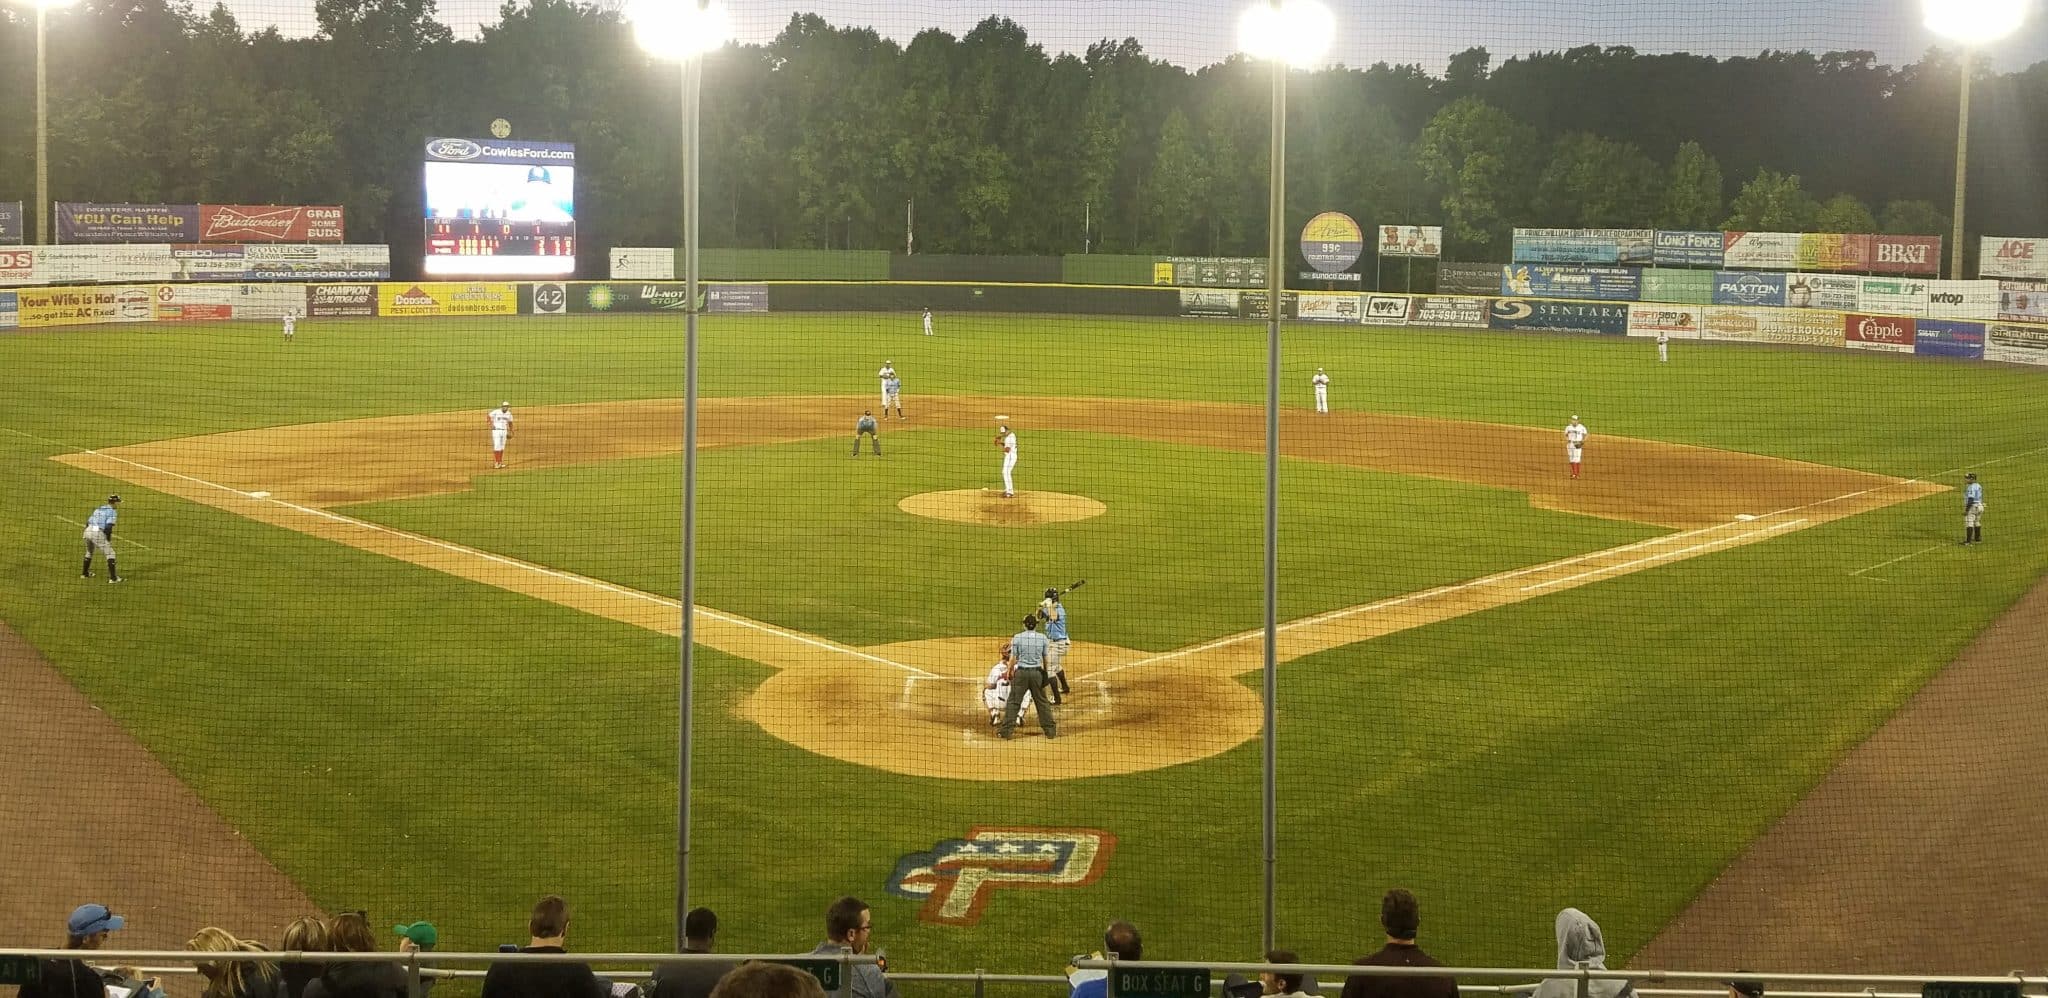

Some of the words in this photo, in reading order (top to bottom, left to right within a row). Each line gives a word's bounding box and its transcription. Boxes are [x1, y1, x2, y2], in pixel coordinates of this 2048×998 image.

[438, 142, 470, 156] Ford
[482, 146, 575, 160] CowlesFord.com
[74, 214, 105, 225] YOU
[110, 214, 142, 225] Can
[147, 214, 184, 226] Help
[306, 209, 341, 218] GRAB
[211, 214, 293, 228] Budweiser
[307, 229, 342, 237] BUDS
[1657, 231, 1686, 246] LONG
[1687, 233, 1721, 248] FENCE
[174, 249, 213, 258] GEICO
[249, 246, 301, 254] COWLES
[1877, 243, 1931, 264] BB&T
[1995, 239, 2035, 259] ACE
[255, 270, 379, 279] COWLESFORD.COM
[316, 286, 371, 296] CHAMPION
[1719, 283, 1780, 295] PAXTON
[20, 296, 49, 307] Your
[51, 294, 80, 306] Wife
[82, 294, 93, 305] is
[95, 294, 115, 305] Hot
[537, 289, 562, 305] 42
[1930, 292, 1964, 306] wtop
[44, 310, 58, 321] get
[76, 308, 91, 318] AC
[93, 309, 115, 317] fixed
[1539, 304, 1624, 318] SENTARA
[1864, 322, 1903, 339] apple
[1122, 974, 1148, 992] BOX
[1154, 974, 1186, 993] SEAT
[1193, 975, 1202, 992] G
